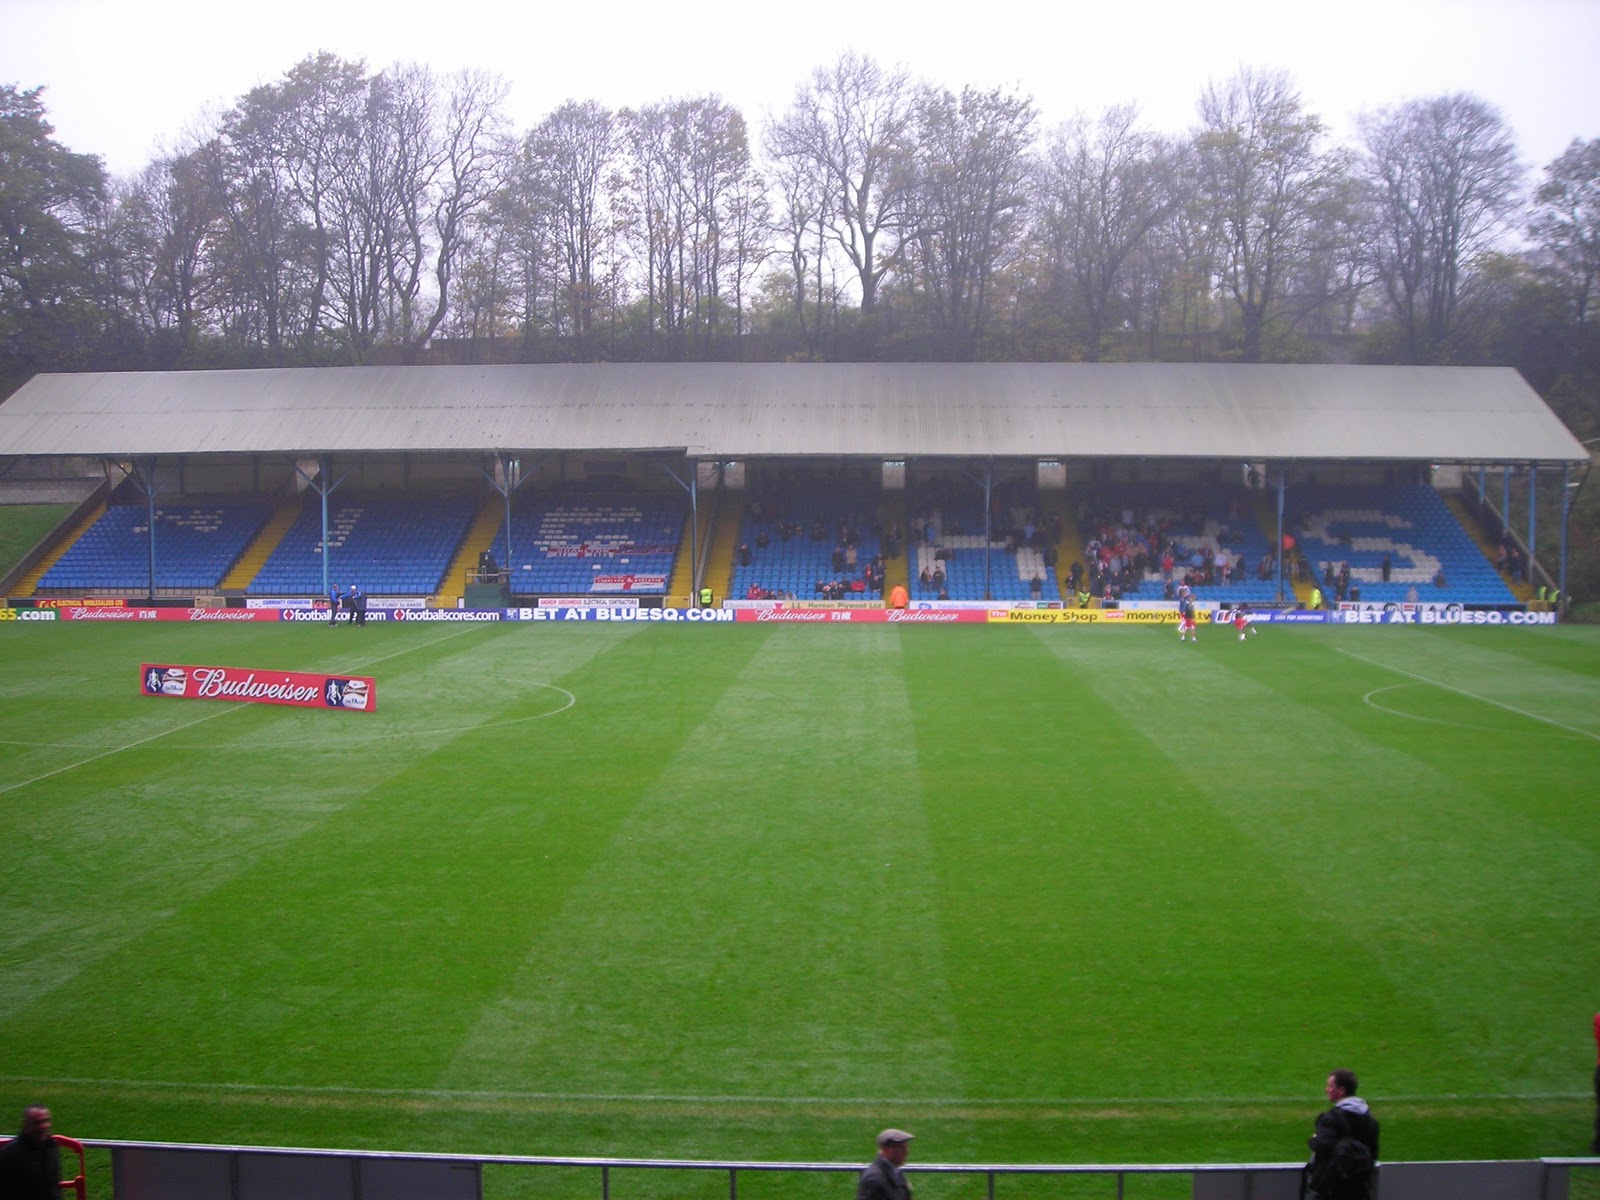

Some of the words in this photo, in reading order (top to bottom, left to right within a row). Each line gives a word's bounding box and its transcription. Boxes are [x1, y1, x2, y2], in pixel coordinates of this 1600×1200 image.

[70, 608, 135, 620] Budweiser
[188, 608, 255, 621] Budweiser
[406, 609, 500, 621] footballscores.com
[520, 608, 559, 620] BET
[564, 608, 591, 620] AT
[596, 608, 733, 621] BLUESQ.COM
[754, 609, 827, 621] Budweiser
[886, 609, 960, 622] Budweiser
[1010, 612, 1058, 623] Money
[1063, 612, 1098, 623] Shop
[1345, 610, 1385, 623] BET
[1390, 611, 1416, 623] AT
[1422, 611, 1556, 624] BLUESQ.COM
[192, 668, 319, 702] Budweiser
